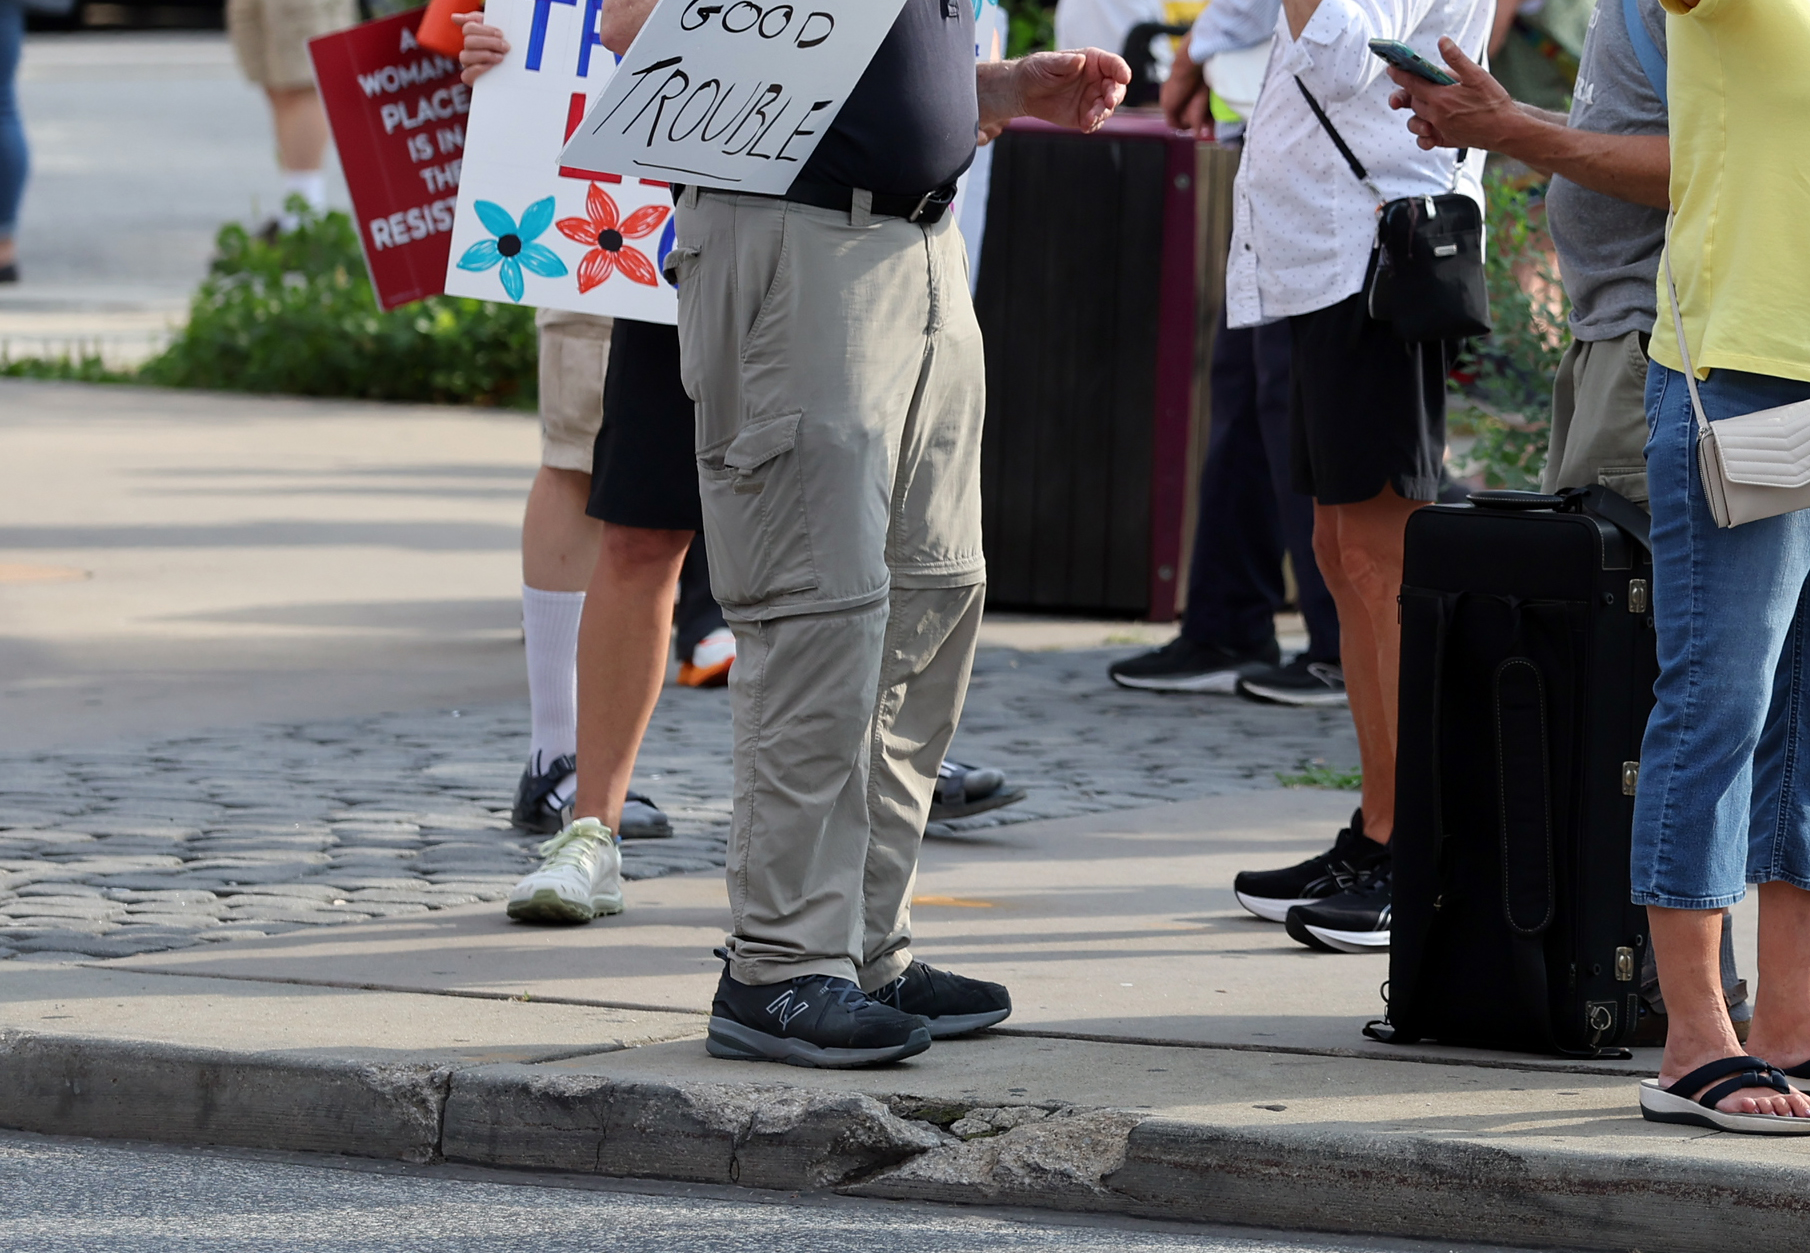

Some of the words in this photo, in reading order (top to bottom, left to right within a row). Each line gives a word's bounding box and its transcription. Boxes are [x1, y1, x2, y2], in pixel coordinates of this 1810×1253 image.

[357, 55, 459, 98] WOMAN
[380, 84, 470, 135] PLACE
[592, 56, 833, 163] TROUBLE
[407, 133, 434, 163] IS
